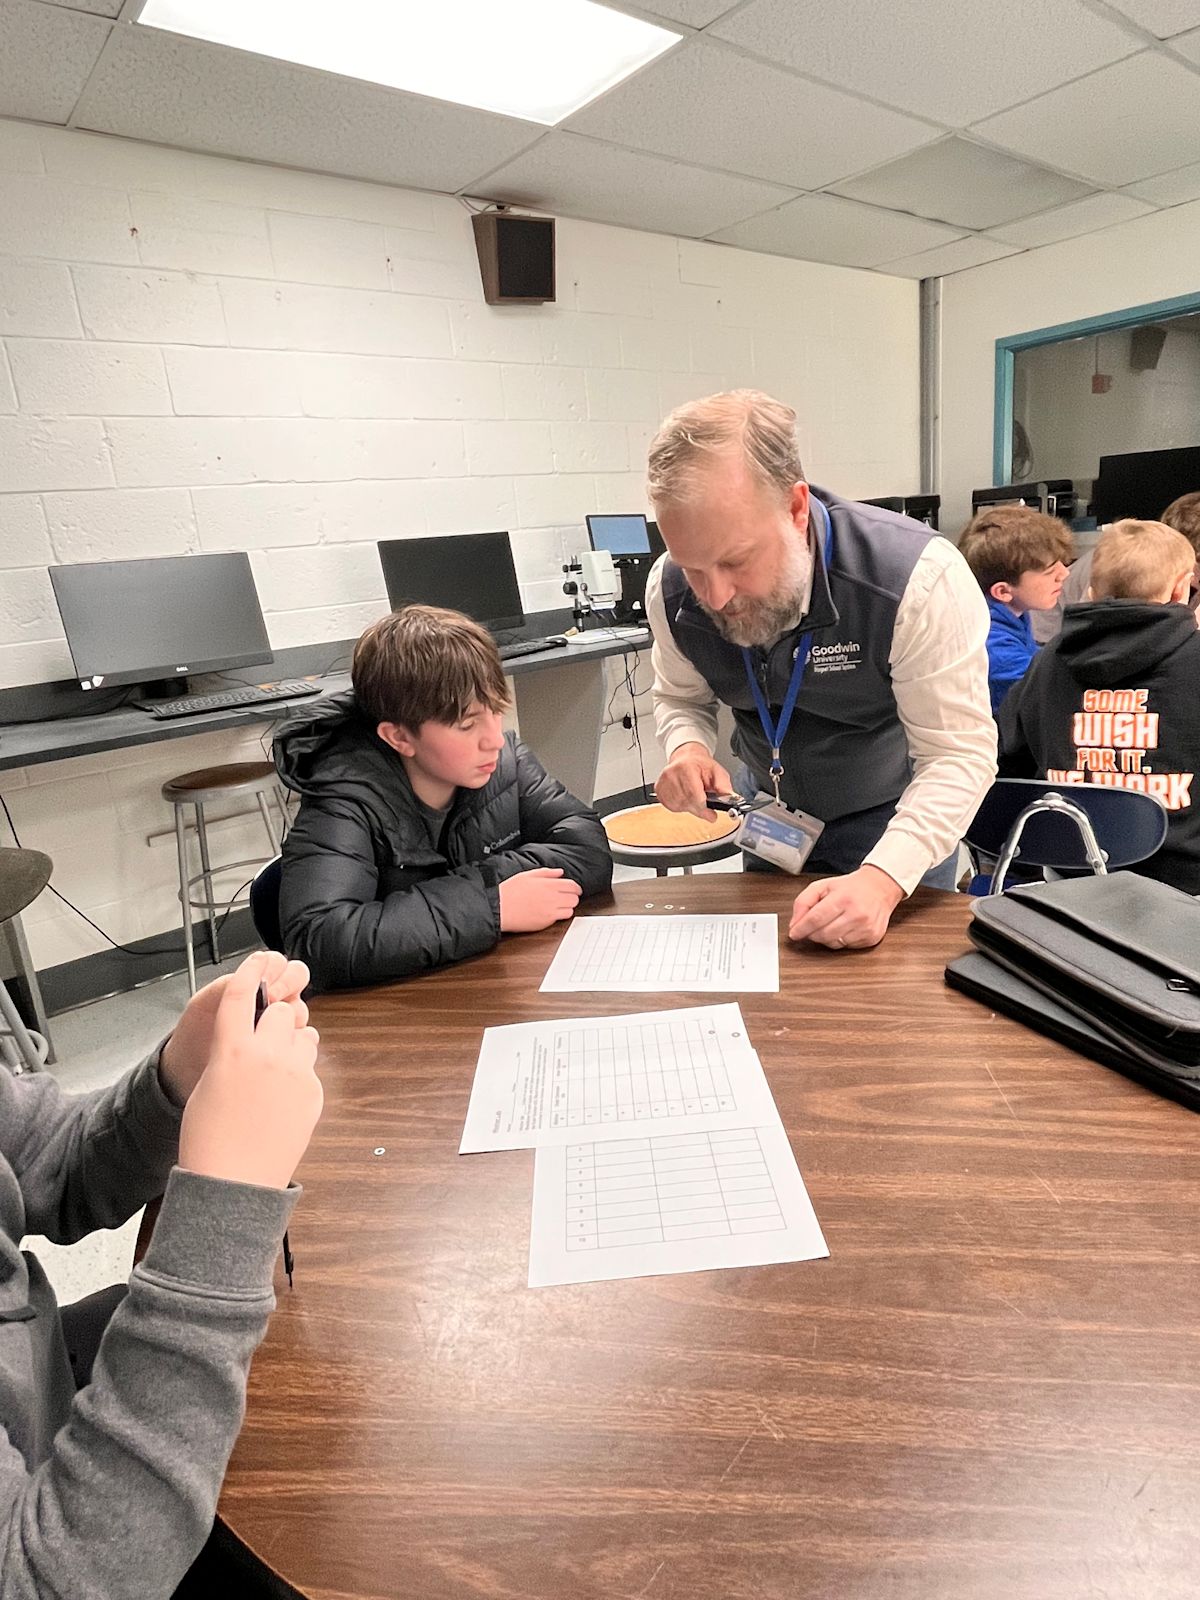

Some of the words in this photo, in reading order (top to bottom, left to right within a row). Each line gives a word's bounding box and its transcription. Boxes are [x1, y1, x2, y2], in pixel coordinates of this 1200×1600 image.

[811, 641, 860, 656] Goodwin
[812, 653, 849, 664] University
[1083, 689, 1149, 713] SOME
[1073, 712, 1160, 748] WISH
[1076, 748, 1118, 772] FOR
[1121, 749, 1152, 773] IT.
